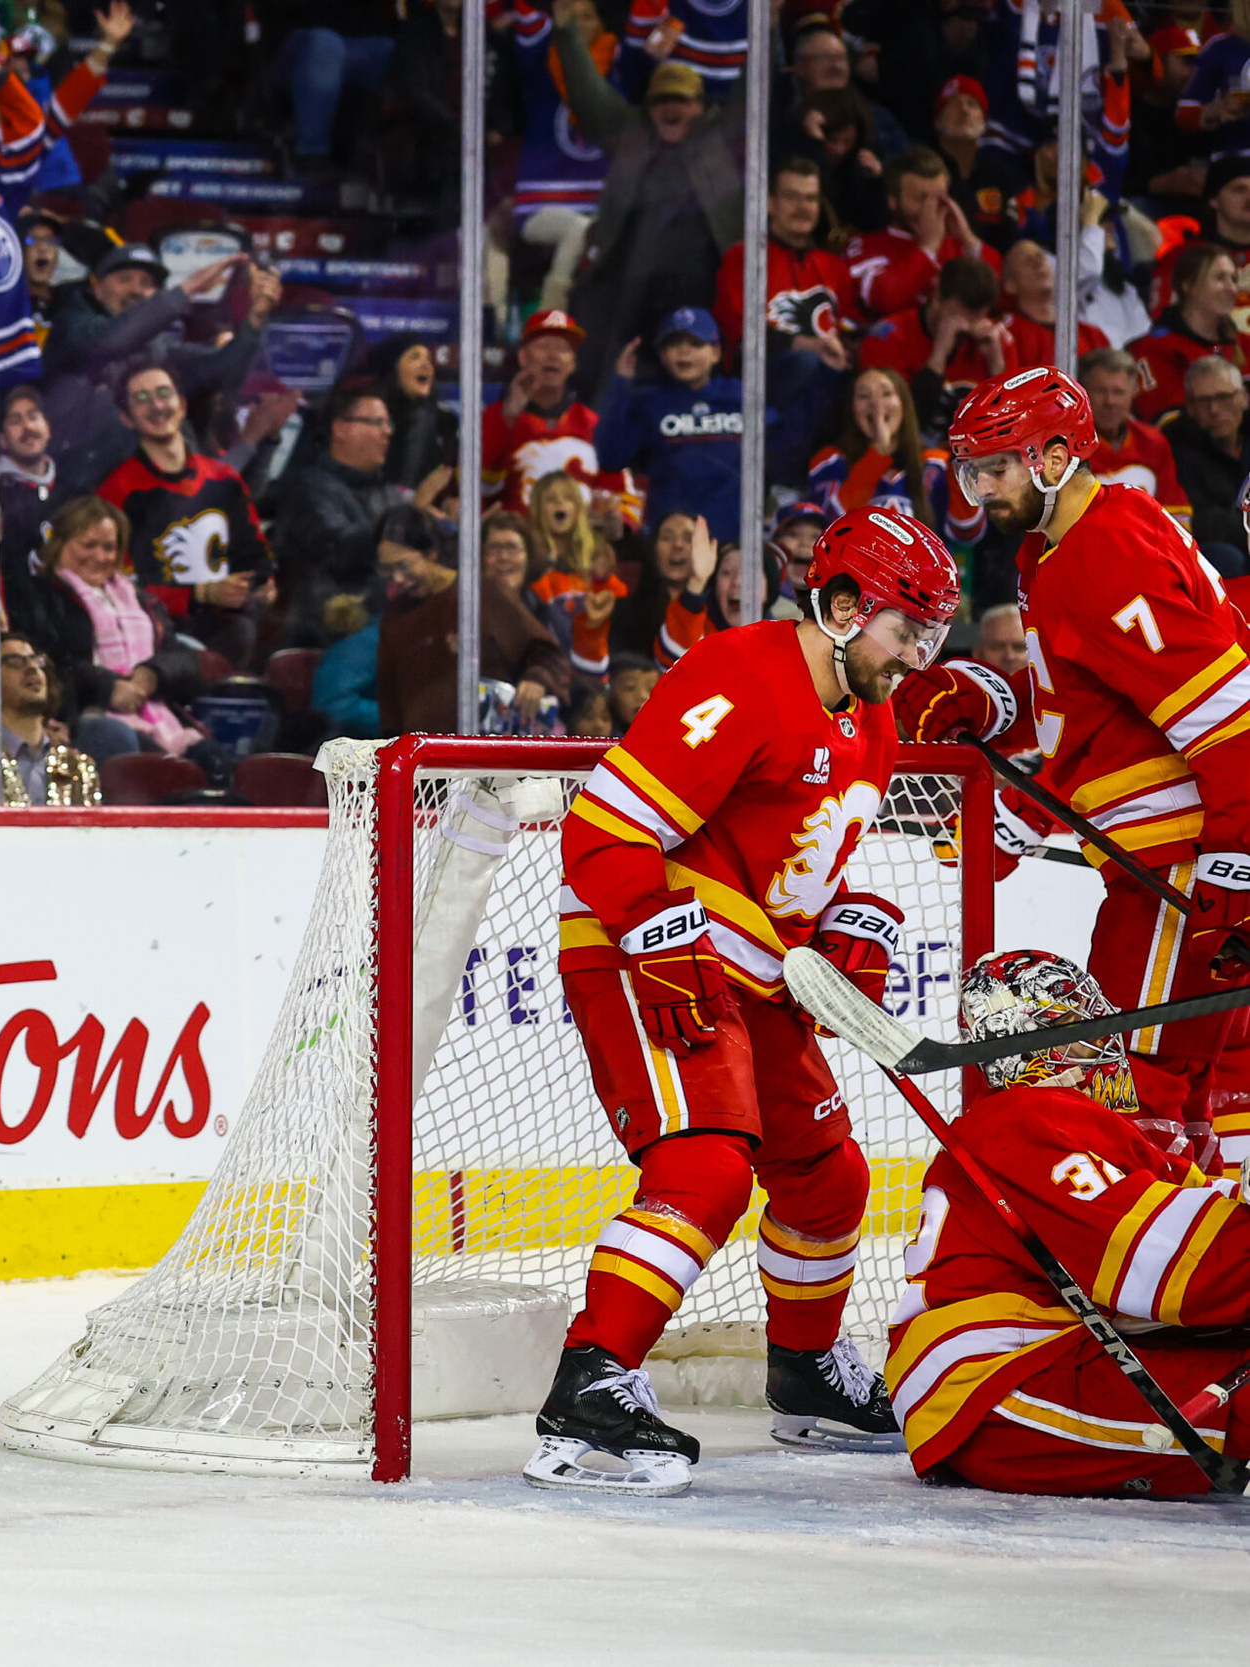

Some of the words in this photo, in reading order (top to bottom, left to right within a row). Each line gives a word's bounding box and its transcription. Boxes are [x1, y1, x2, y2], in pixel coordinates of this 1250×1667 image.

[870, 513, 911, 543] GameSense
[1110, 594, 1166, 655] 7
[679, 693, 736, 750] 4
[813, 1089, 843, 1121] CC
[1061, 1285, 1143, 1375] CCM
